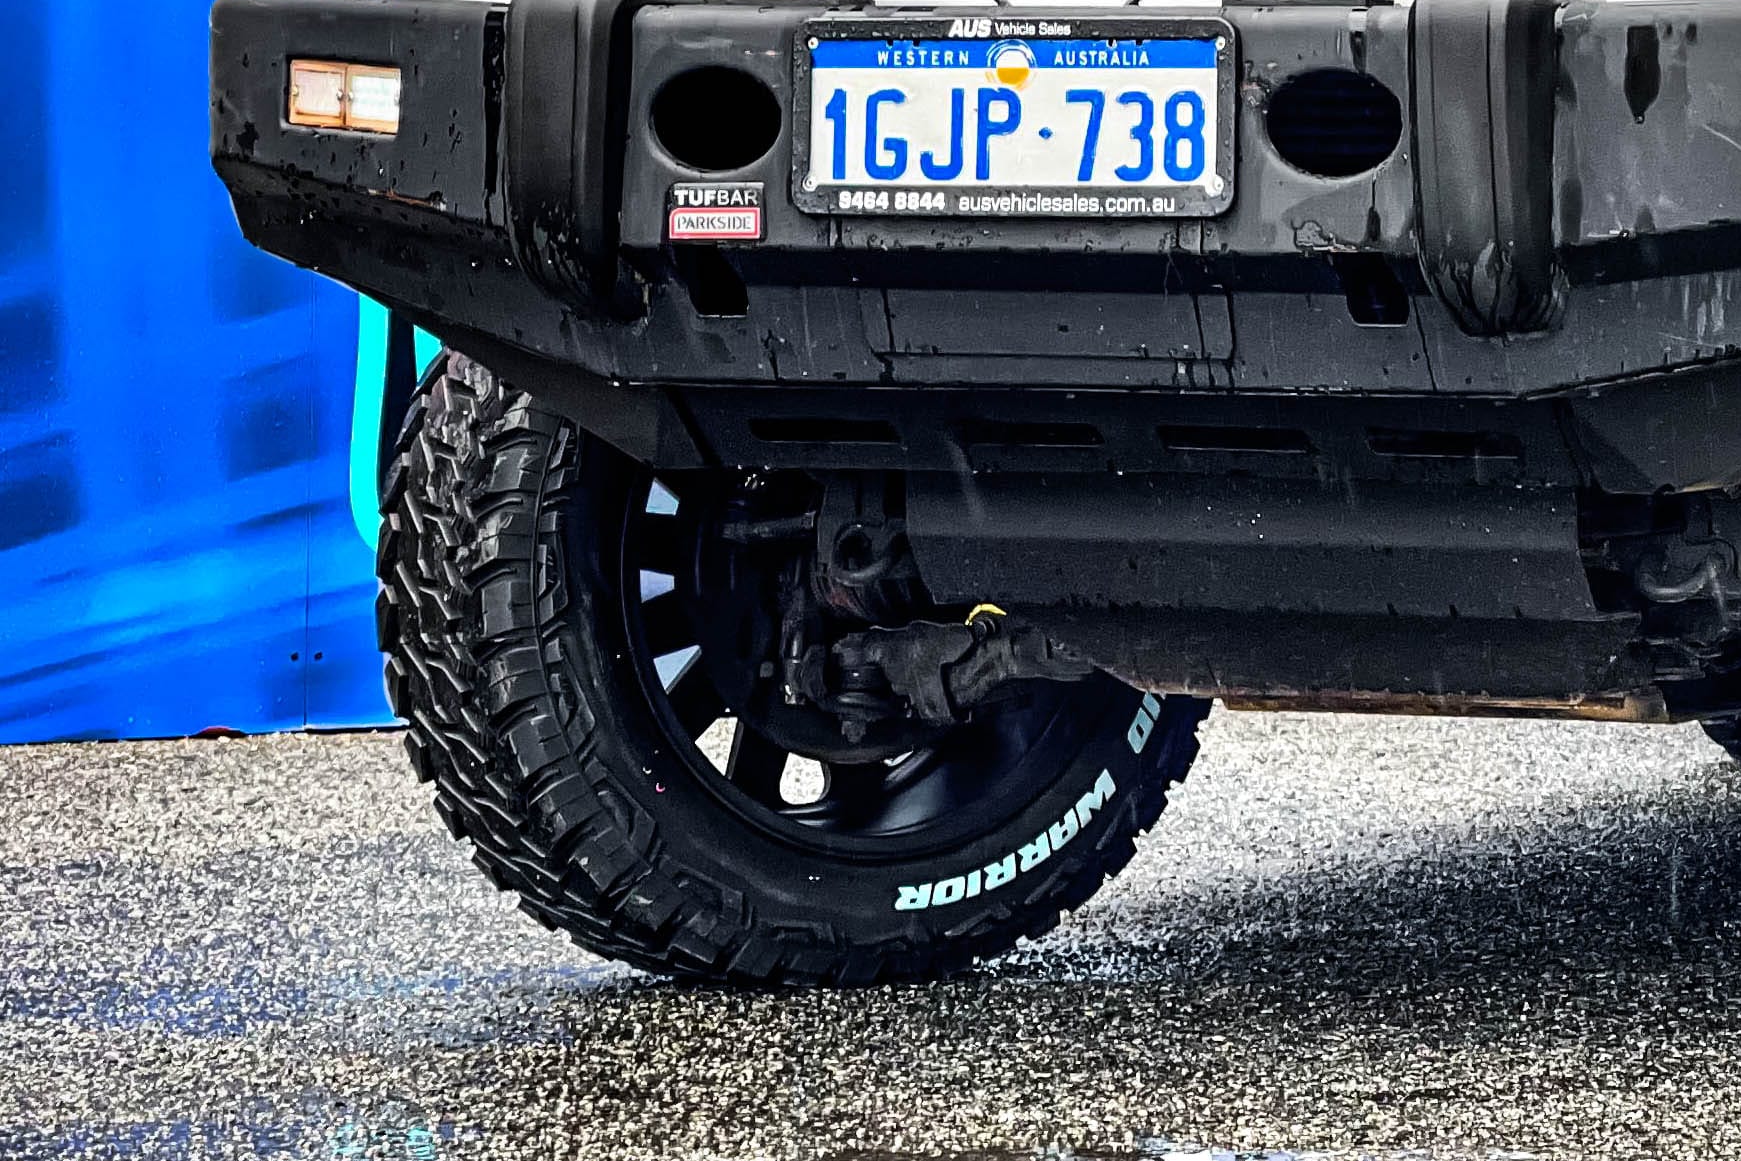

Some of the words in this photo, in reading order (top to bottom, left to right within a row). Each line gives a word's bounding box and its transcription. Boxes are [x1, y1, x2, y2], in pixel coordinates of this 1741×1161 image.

[948, 19, 992, 38] AUS
[994, 22, 1036, 36] Vehicle
[1038, 22, 1071, 36] Sales
[877, 50, 970, 66] WESTERN
[1053, 50, 1150, 66] AUSTRALIA
[674, 189, 758, 206] TUFBAR
[838, 191, 889, 210] 9464
[958, 191, 1175, 213] ausvehiclesales.com.au
[677, 215, 752, 229] PARKSIDE
[895, 768, 1117, 911] WARRIOR
